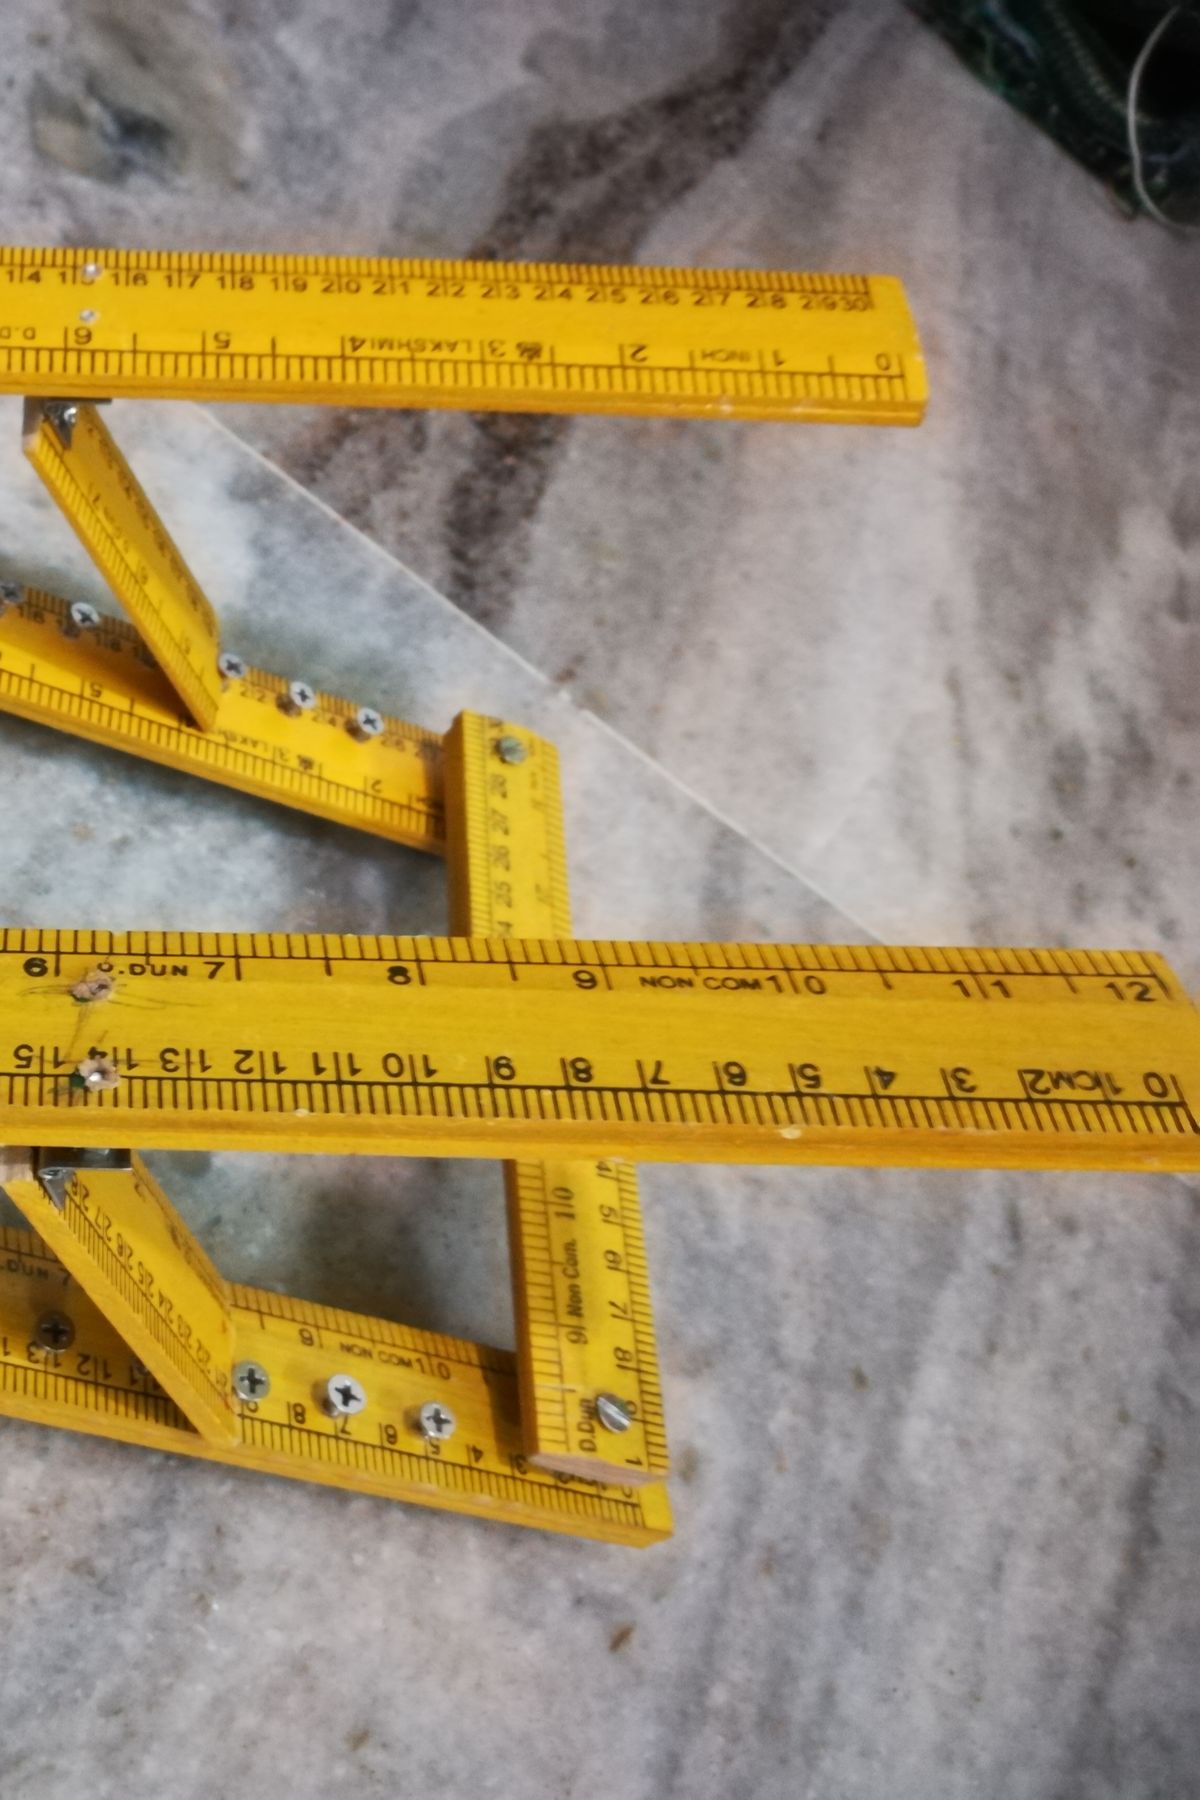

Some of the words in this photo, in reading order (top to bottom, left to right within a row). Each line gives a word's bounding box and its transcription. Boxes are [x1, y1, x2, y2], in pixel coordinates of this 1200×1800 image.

[7, 269, 41, 284] 14
[112, 272, 148, 287] 16
[165, 274, 200, 288] 17
[218, 275, 255, 290] 18
[272, 276, 307, 292] 19
[321, 278, 361, 294] 20
[373, 280, 409, 295] 21
[427, 281, 465, 297] 22
[481, 283, 520, 300] 23
[535, 285, 572, 301] 24
[587, 287, 626, 302] 25
[640, 289, 679, 305] 26
[694, 290, 730, 307] 27
[747, 292, 786, 309] 28
[802, 294, 837, 310] 29
[841, 295, 871, 312] 30
[23, 958, 48, 977] 6
[204, 961, 224, 979] 7
[387, 966, 411, 985] 8
[573, 970, 598, 990] 9
[639, 976, 695, 989] NON
[703, 977, 762, 990] COM
[766, 975, 827, 995] 10
[953, 979, 1010, 998] 11
[1105, 981, 1156, 1001] 12
[13, 1043, 66, 1068] 15
[159, 1047, 212, 1072] 13
[233, 1049, 287, 1075] 12
[313, 1052, 362, 1076] 11
[382, 1052, 438, 1078] 10
[493, 1055, 516, 1080] 9
[569, 1057, 594, 1083] 8
[651, 1060, 670, 1085] 7
[723, 1061, 747, 1086] 6
[797, 1063, 822, 1088] 5
[874, 1066, 897, 1090] 4
[950, 1067, 977, 1092] 3
[1023, 1069, 1050, 1094] 2
[1103, 1072, 1122, 1095] 1
[1143, 1072, 1168, 1097] 0
[77, 1354, 112, 1379] 12
[299, 1329, 314, 1346] 9
[340, 1342, 373, 1359] NON
[378, 1351, 413, 1368] COM
[415, 1357, 451, 1380] 10
[293, 1403, 306, 1424] 8
[384, 1424, 397, 1445] 6
[471, 1445, 484, 1463] 4
